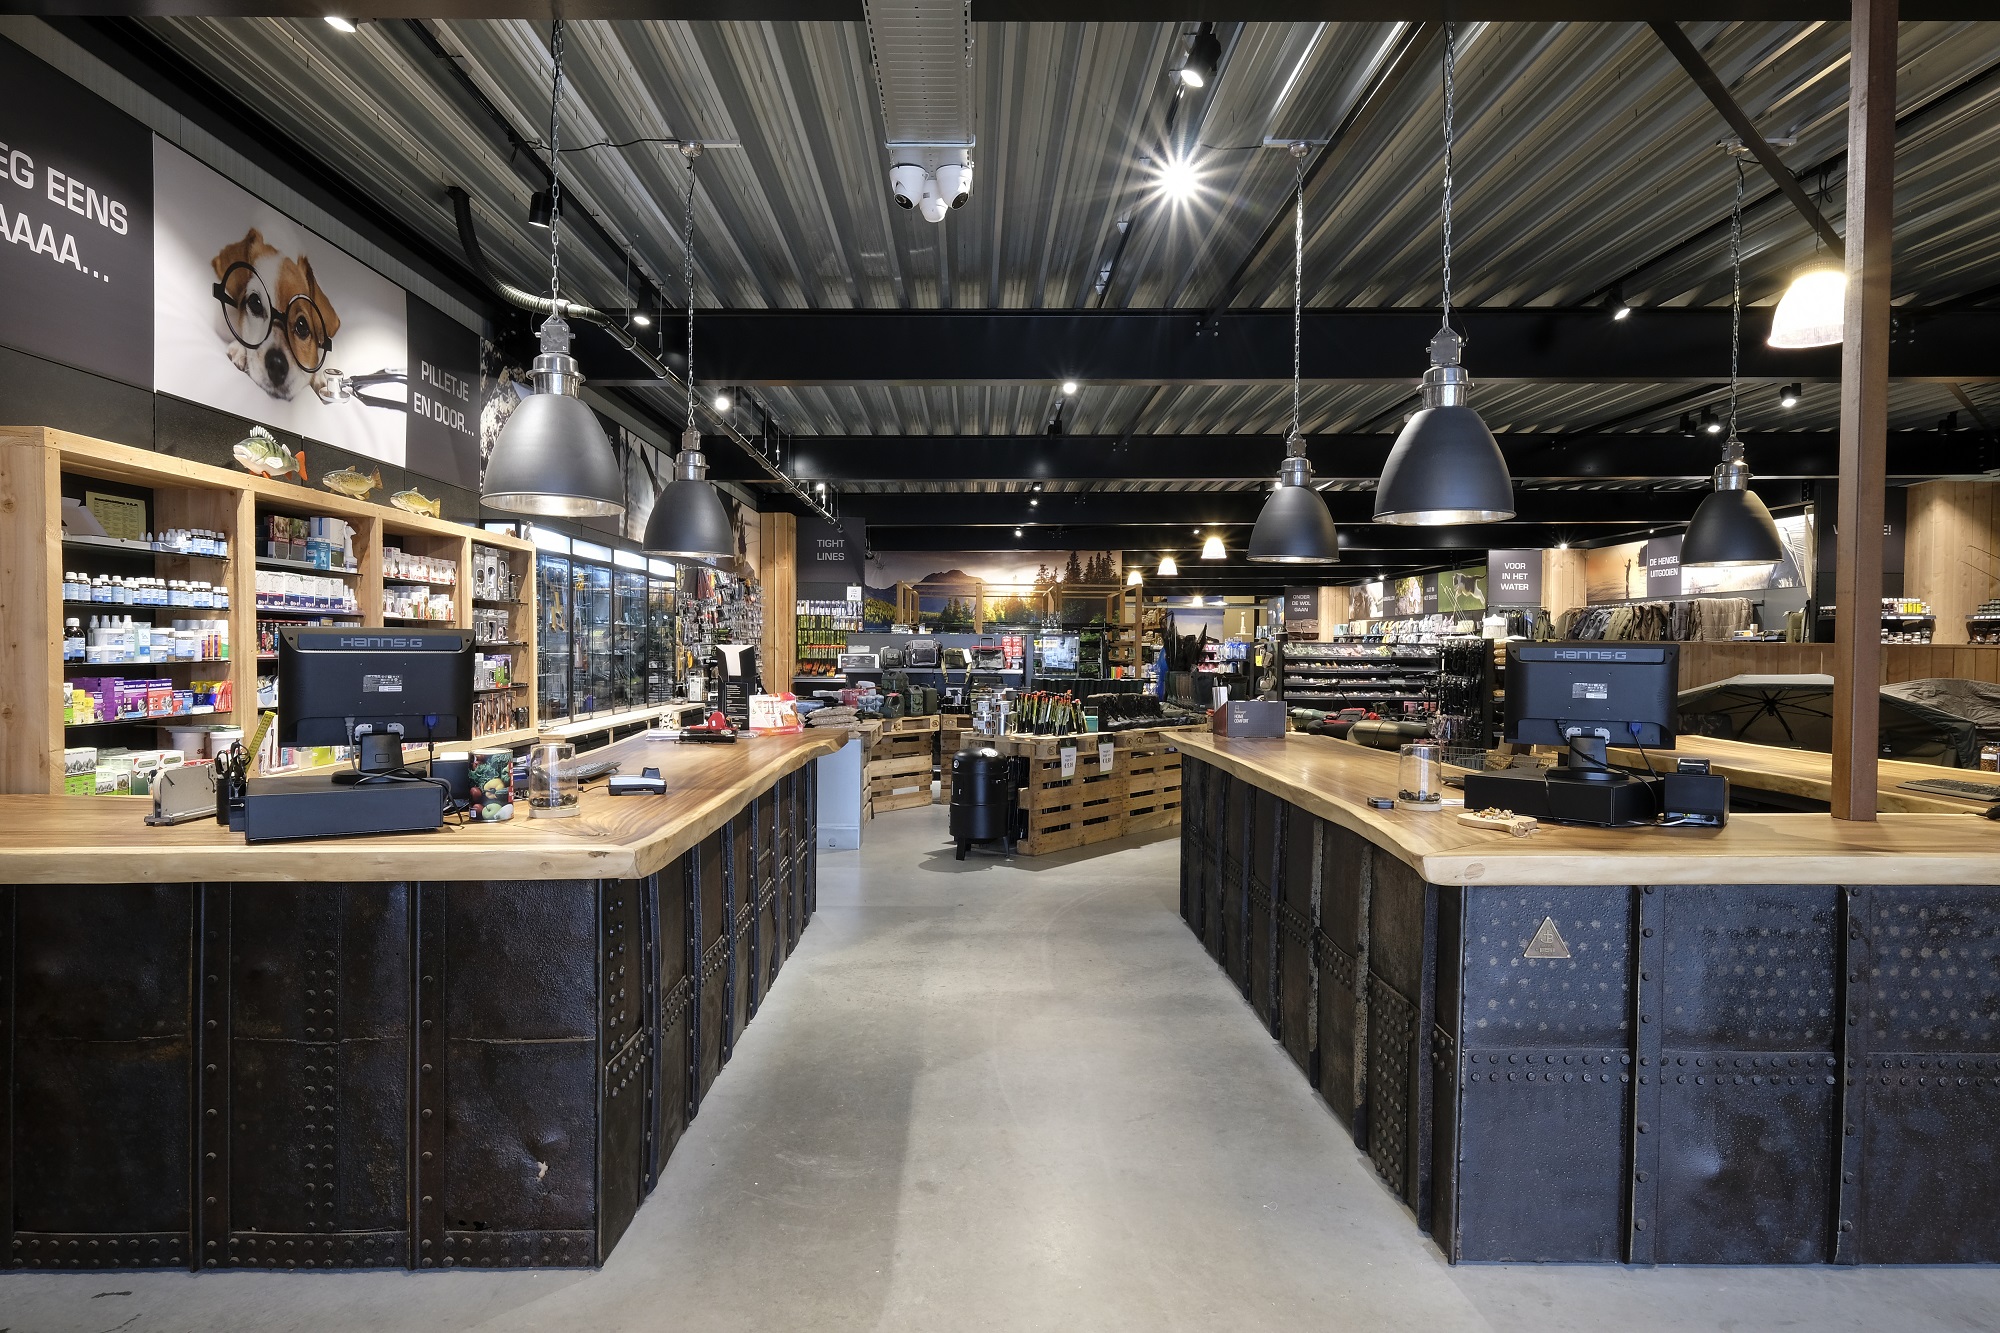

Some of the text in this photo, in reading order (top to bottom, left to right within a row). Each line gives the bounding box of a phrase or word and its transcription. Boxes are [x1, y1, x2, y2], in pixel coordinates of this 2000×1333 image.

[47, 166, 128, 236] EENS
[421, 360, 469, 402] PILLETJE
[413, 391, 475, 437] EN DOOR...
[816, 539, 845, 548] TIGHT
[816, 552, 845, 561] LINES
[1649, 555, 1680, 567] DE HENGEL
[1504, 562, 1526, 570] VOOR
[1501, 572, 1529, 580] IN HET
[1500, 582, 1529, 591] WATER
